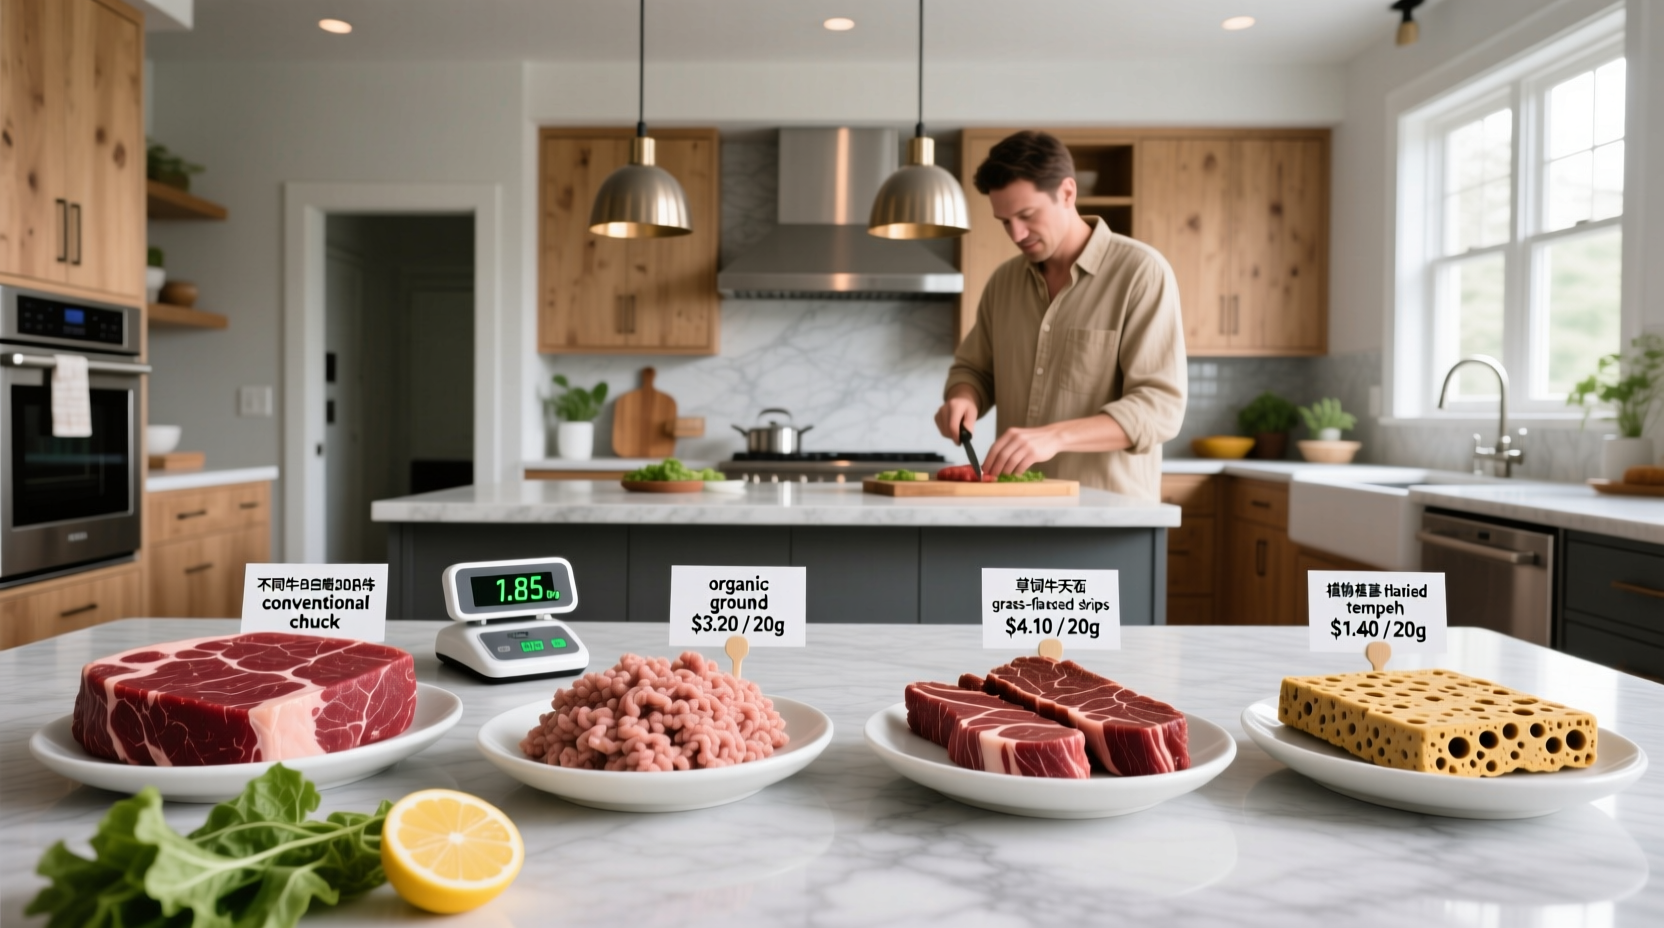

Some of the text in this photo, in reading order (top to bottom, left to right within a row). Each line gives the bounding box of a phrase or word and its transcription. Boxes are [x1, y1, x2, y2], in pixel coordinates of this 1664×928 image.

[496, 575, 544, 602] 1.85
[709, 575, 769, 595] organic
[262, 594, 370, 610] conventional
[710, 594, 768, 614] ground
[1346, 600, 1404, 619] tempeh
[289, 613, 341, 629] chuck
[691, 613, 785, 637] $3.20 / 20g
[1005, 616, 1100, 639] $4.10 / 20g
[1330, 617, 1426, 643] $1.40 / 20g
